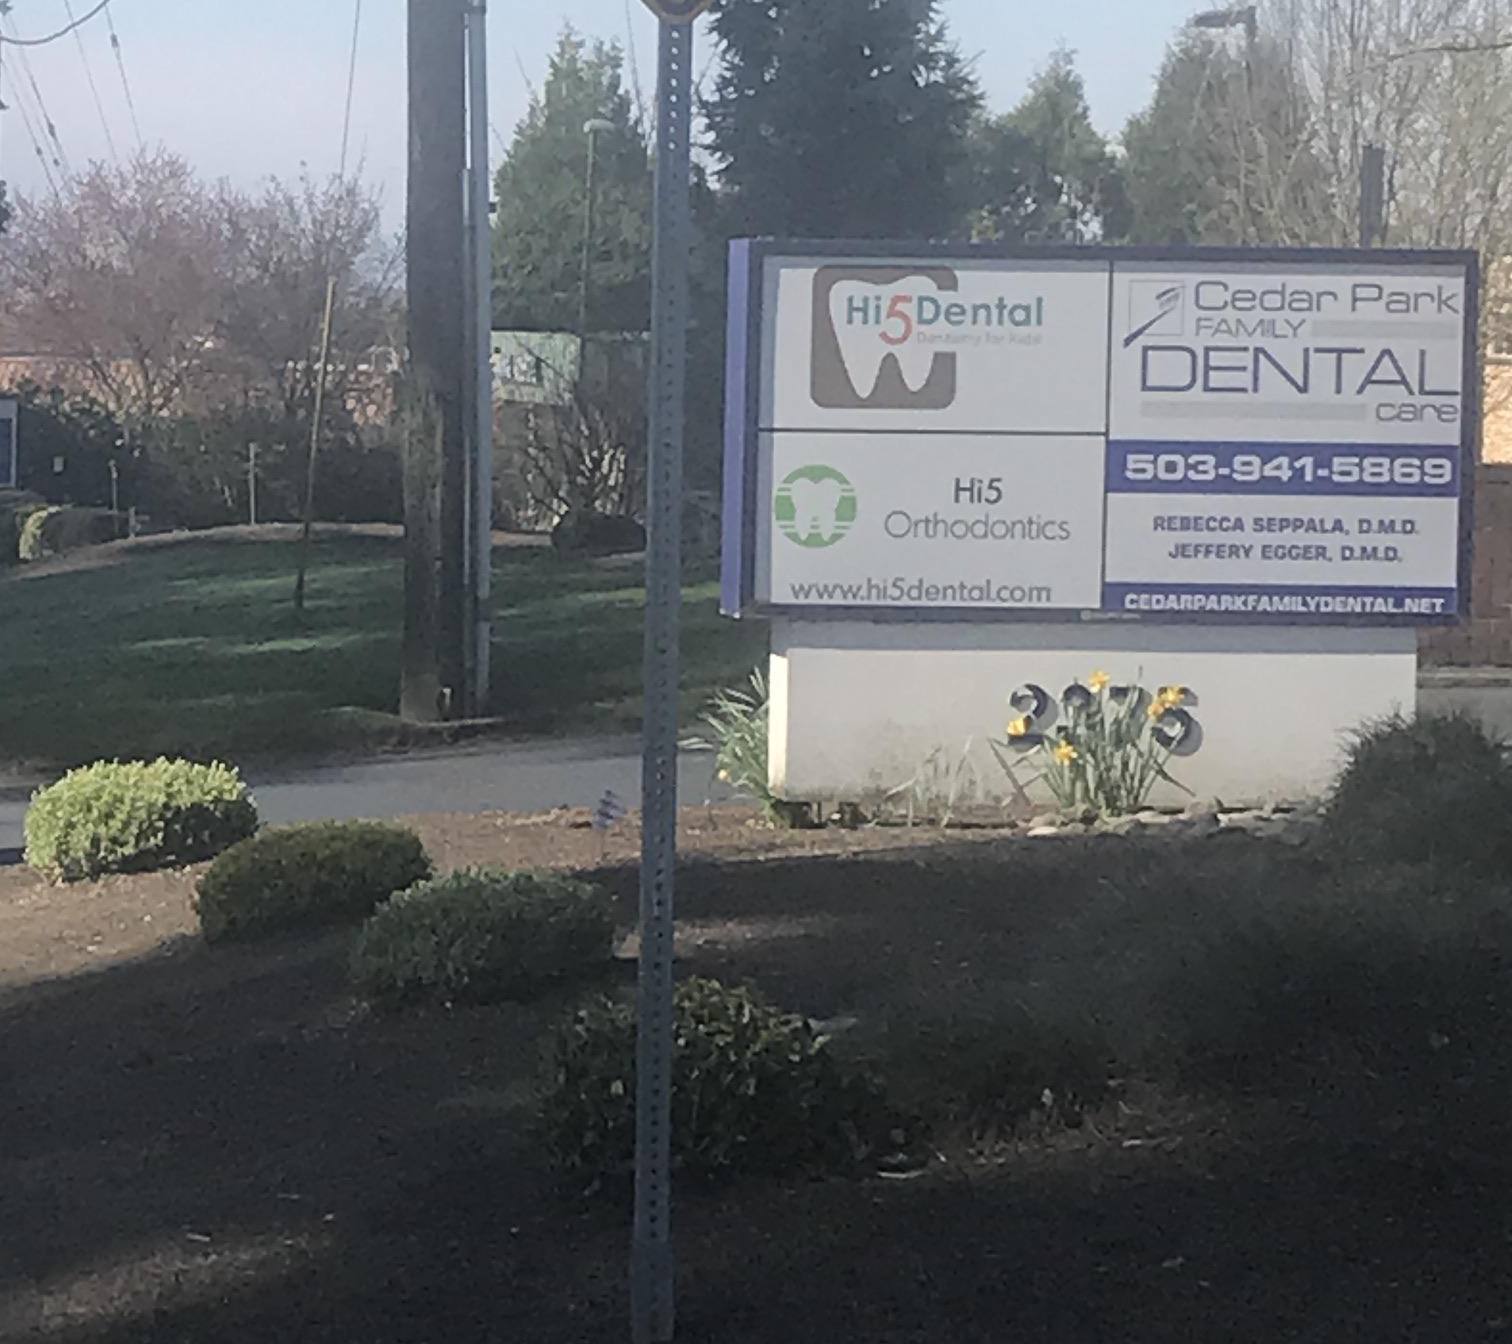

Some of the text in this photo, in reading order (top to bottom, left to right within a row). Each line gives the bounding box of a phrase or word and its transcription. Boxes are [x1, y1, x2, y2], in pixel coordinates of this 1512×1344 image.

[1194, 280, 1460, 314] Cedar Park
[1195, 317, 1306, 339] FAMILY
[1141, 345, 1460, 397] DENTAL
[1375, 403, 1459, 423] care
[1124, 454, 1452, 484] 503-941-5869
[954, 477, 1003, 505] Hi5
[884, 509, 1071, 541] Orthodontics
[1153, 515, 1419, 535] REBECCA SEPPALA, D.M.D.
[1169, 543, 1403, 562] JEFFERY EGGER, D.M.D.
[790, 577, 1052, 603] www.hi5dental.com
[1124, 593, 1445, 613] CEDARPARKFAMILYDENTAL.NET
